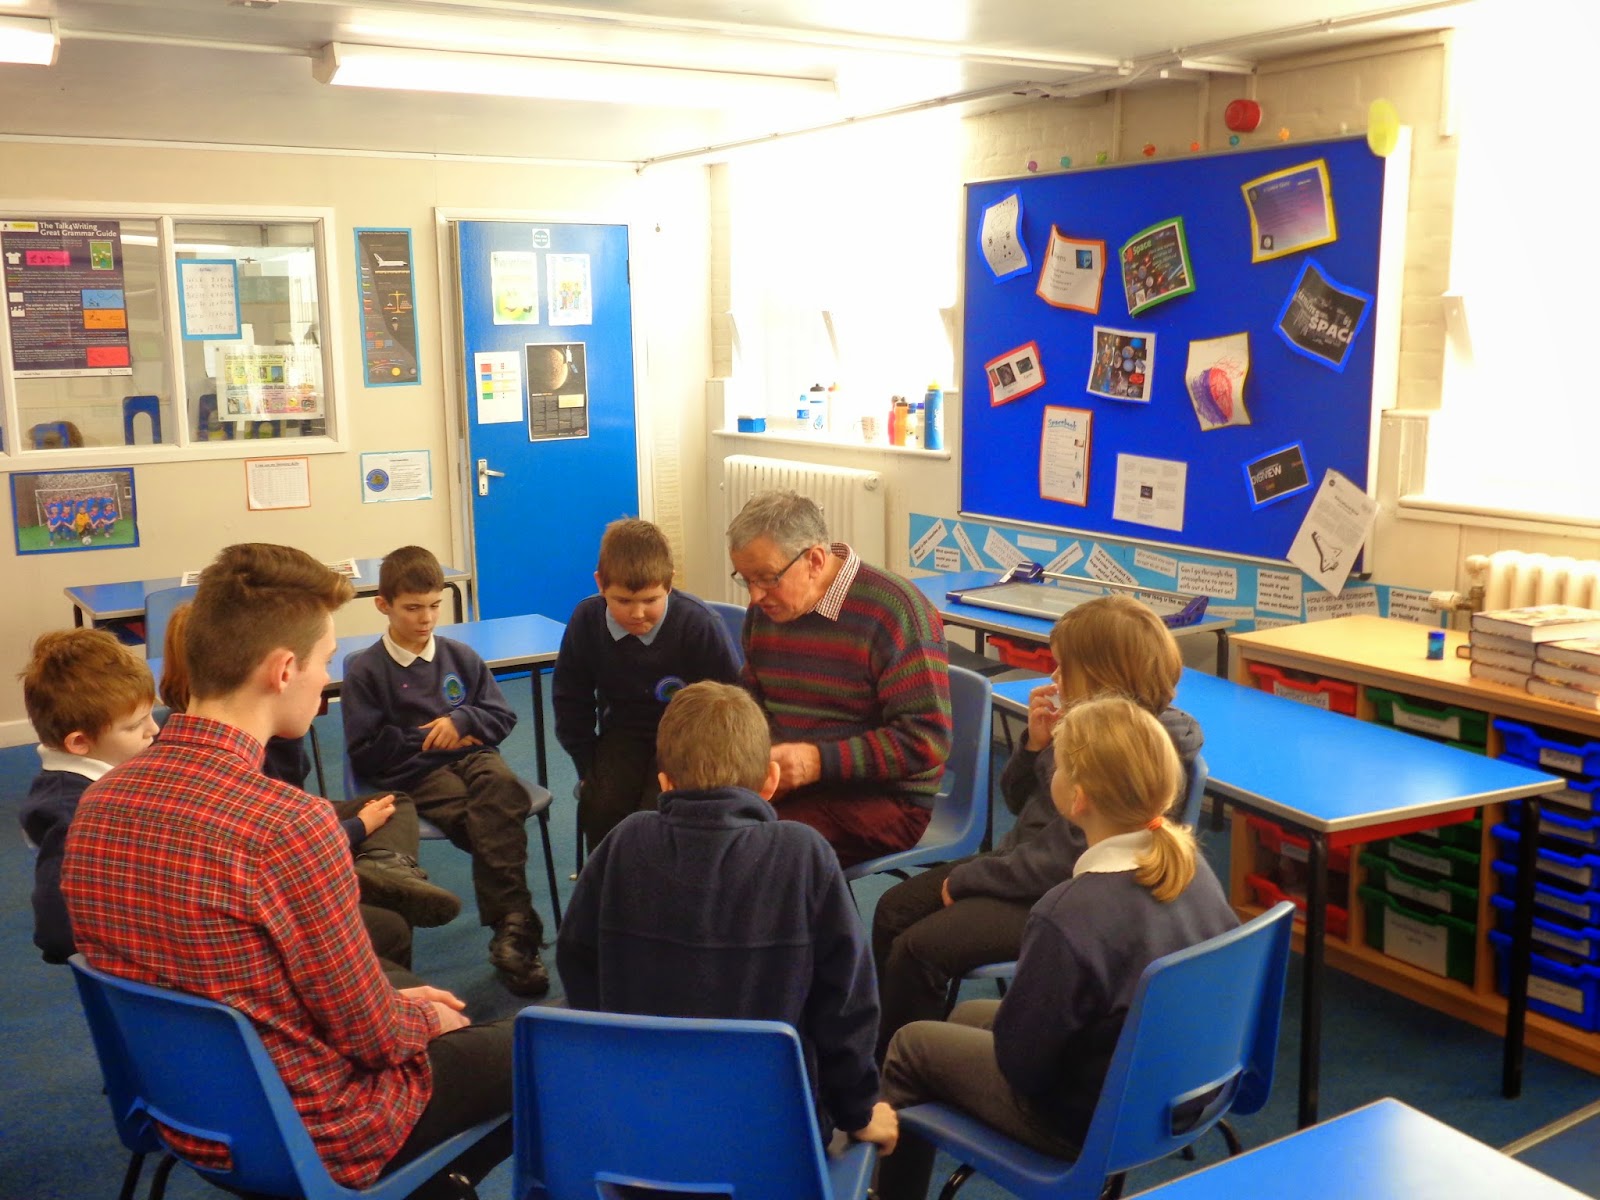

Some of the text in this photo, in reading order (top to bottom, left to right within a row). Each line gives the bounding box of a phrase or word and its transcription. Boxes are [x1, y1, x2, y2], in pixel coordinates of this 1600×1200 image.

[55, 222, 98, 231] Talk4Writing
[40, 229, 61, 237] Great
[62, 229, 94, 237] Grammar
[1133, 240, 1153, 254] Space
[1202, 568, 1223, 578] through
[1205, 585, 1224, 594] helmet
[1307, 596, 1320, 604] How
[1346, 592, 1374, 601] compare
[1278, 602, 1299, 611] Saturn?
[1326, 604, 1343, 612] space
[1421, 606, 1437, 614] need
[1398, 612, 1414, 621] build
